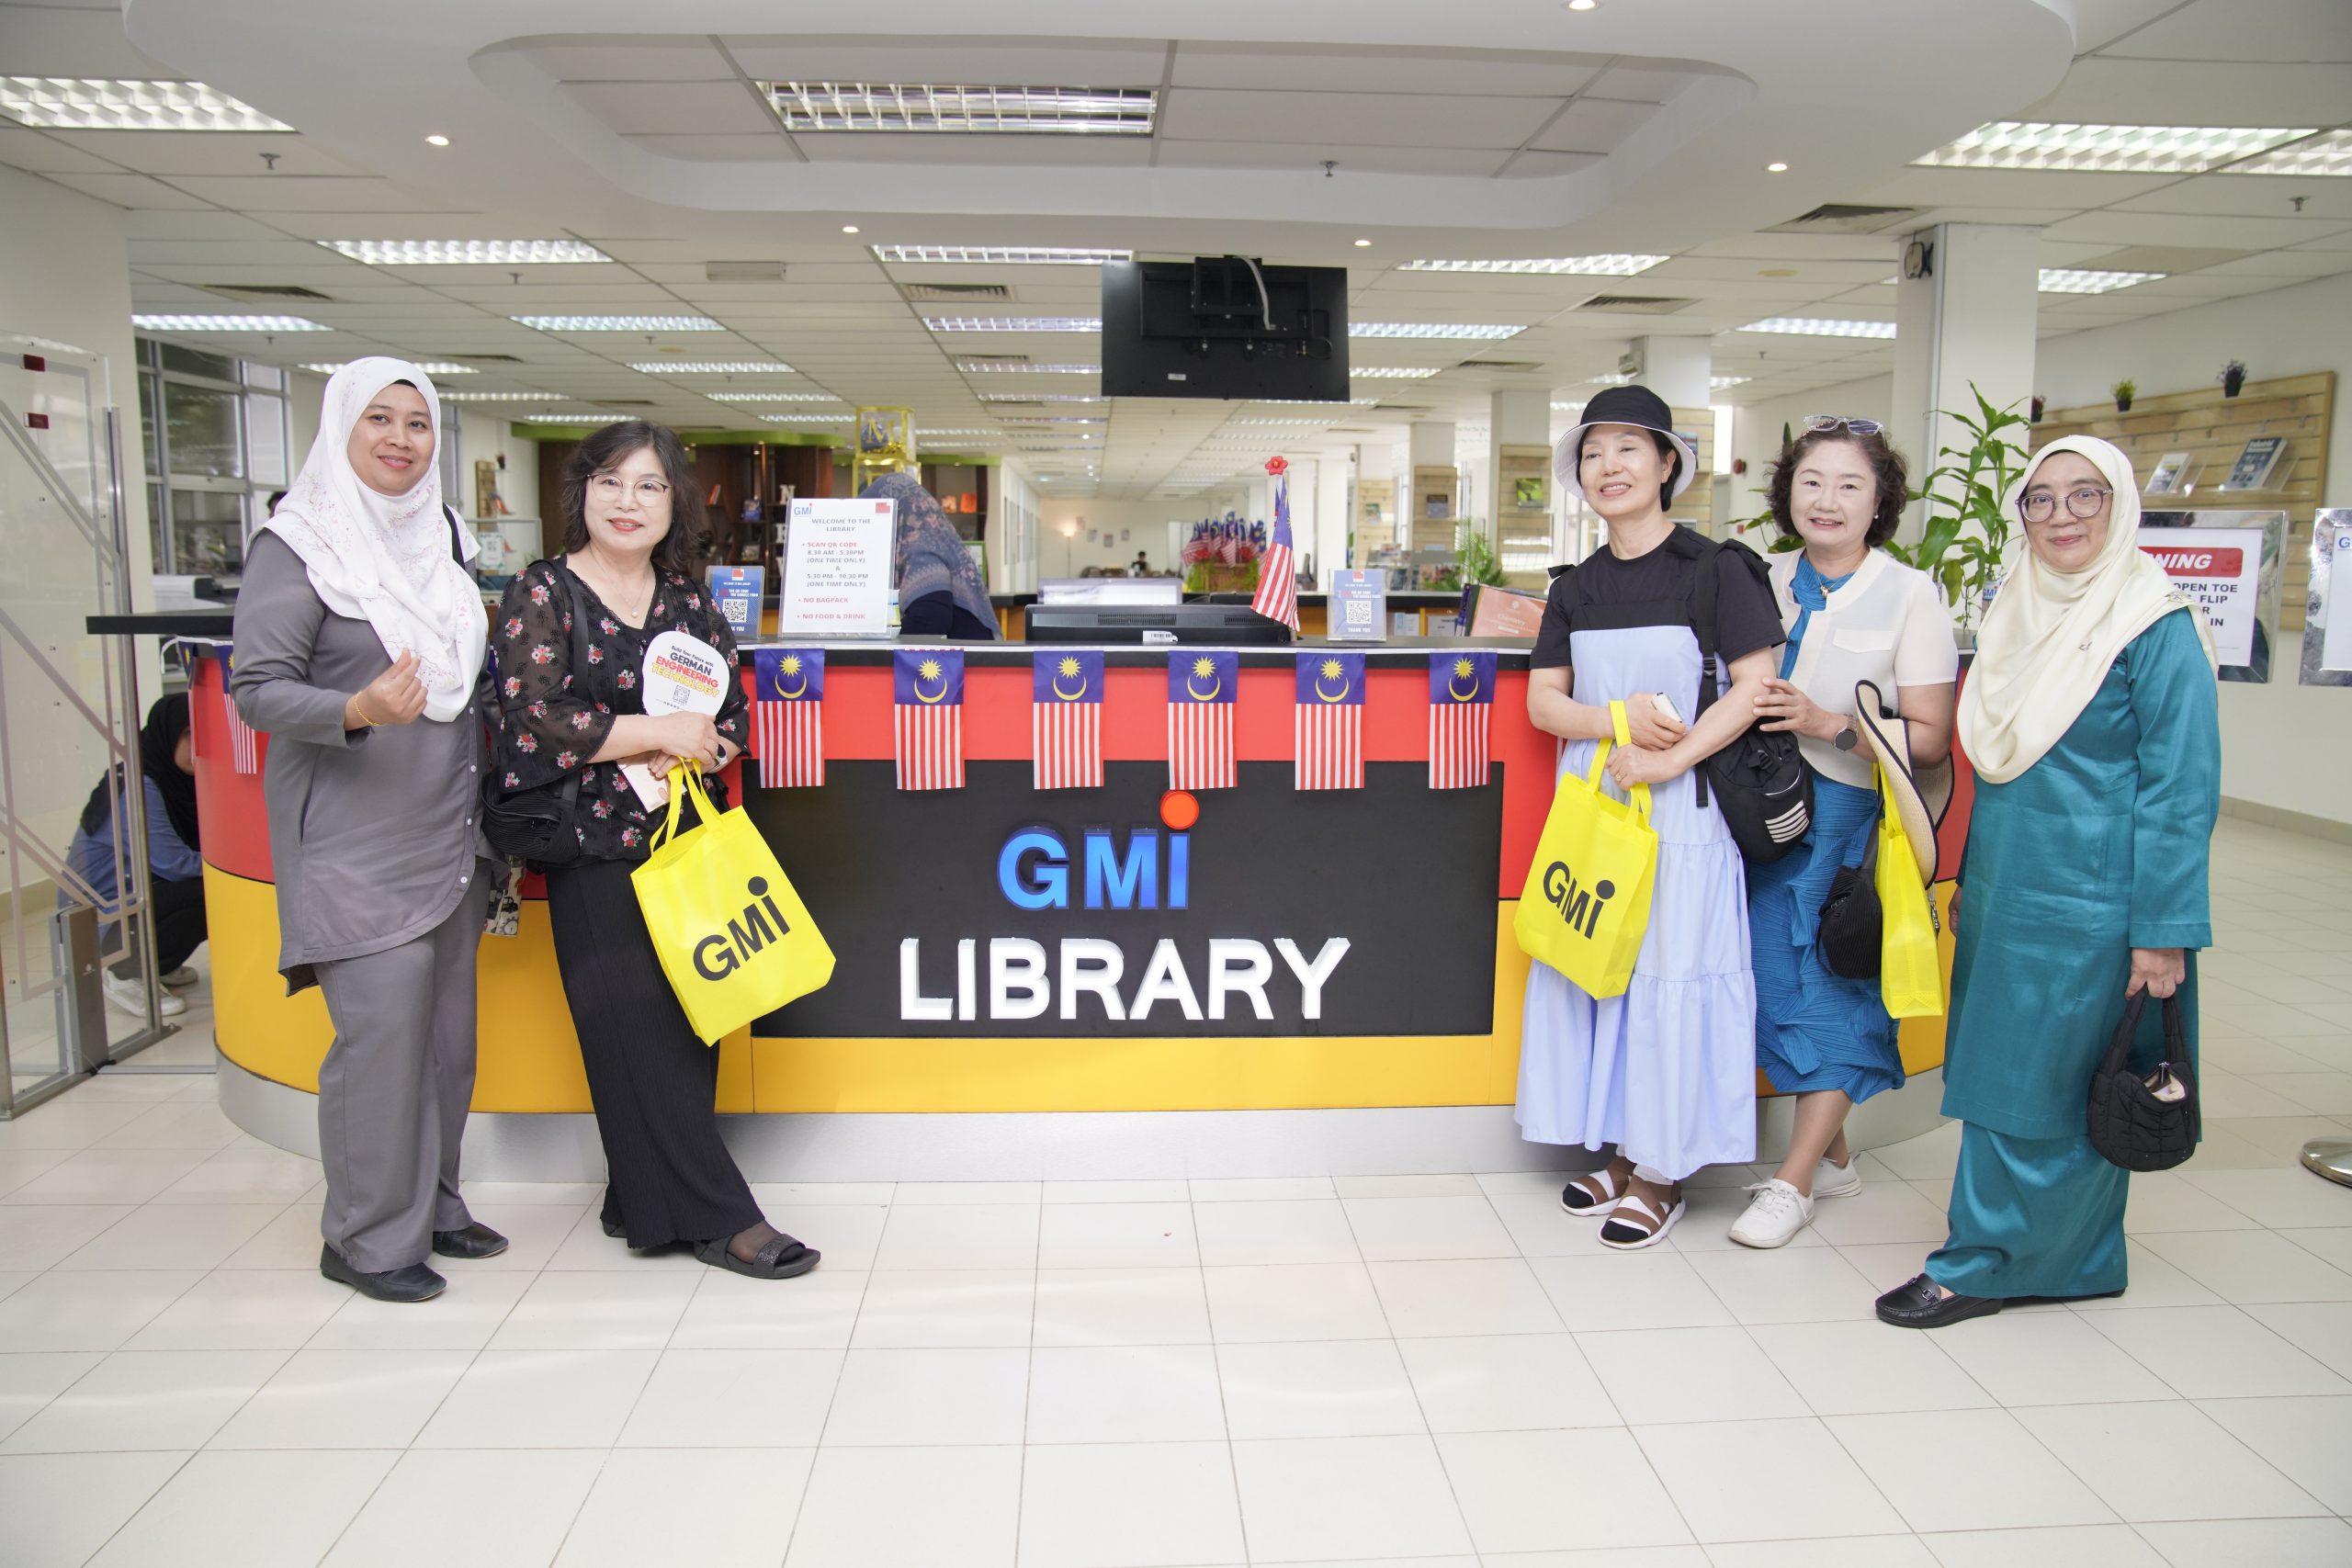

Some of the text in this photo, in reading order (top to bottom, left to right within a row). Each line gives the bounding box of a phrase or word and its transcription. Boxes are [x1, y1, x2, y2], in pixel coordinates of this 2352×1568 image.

[794, 502, 812, 514] GMi
[2151, 553, 2212, 569] NING
[2199, 595, 2228, 604] FLIP
[2211, 584, 2238, 592] TOE
[2210, 618, 2223, 626] IN
[656, 655, 718, 688] ENGINEERING
[670, 652, 712, 676] GERMAN
[651, 661, 719, 697] TECHNOLOGY
[997, 789, 1199, 910] GMi
[1543, 861, 1615, 940] GMi
[693, 875, 791, 981] GMi
[899, 937, 1351, 1021] LIBRARY
